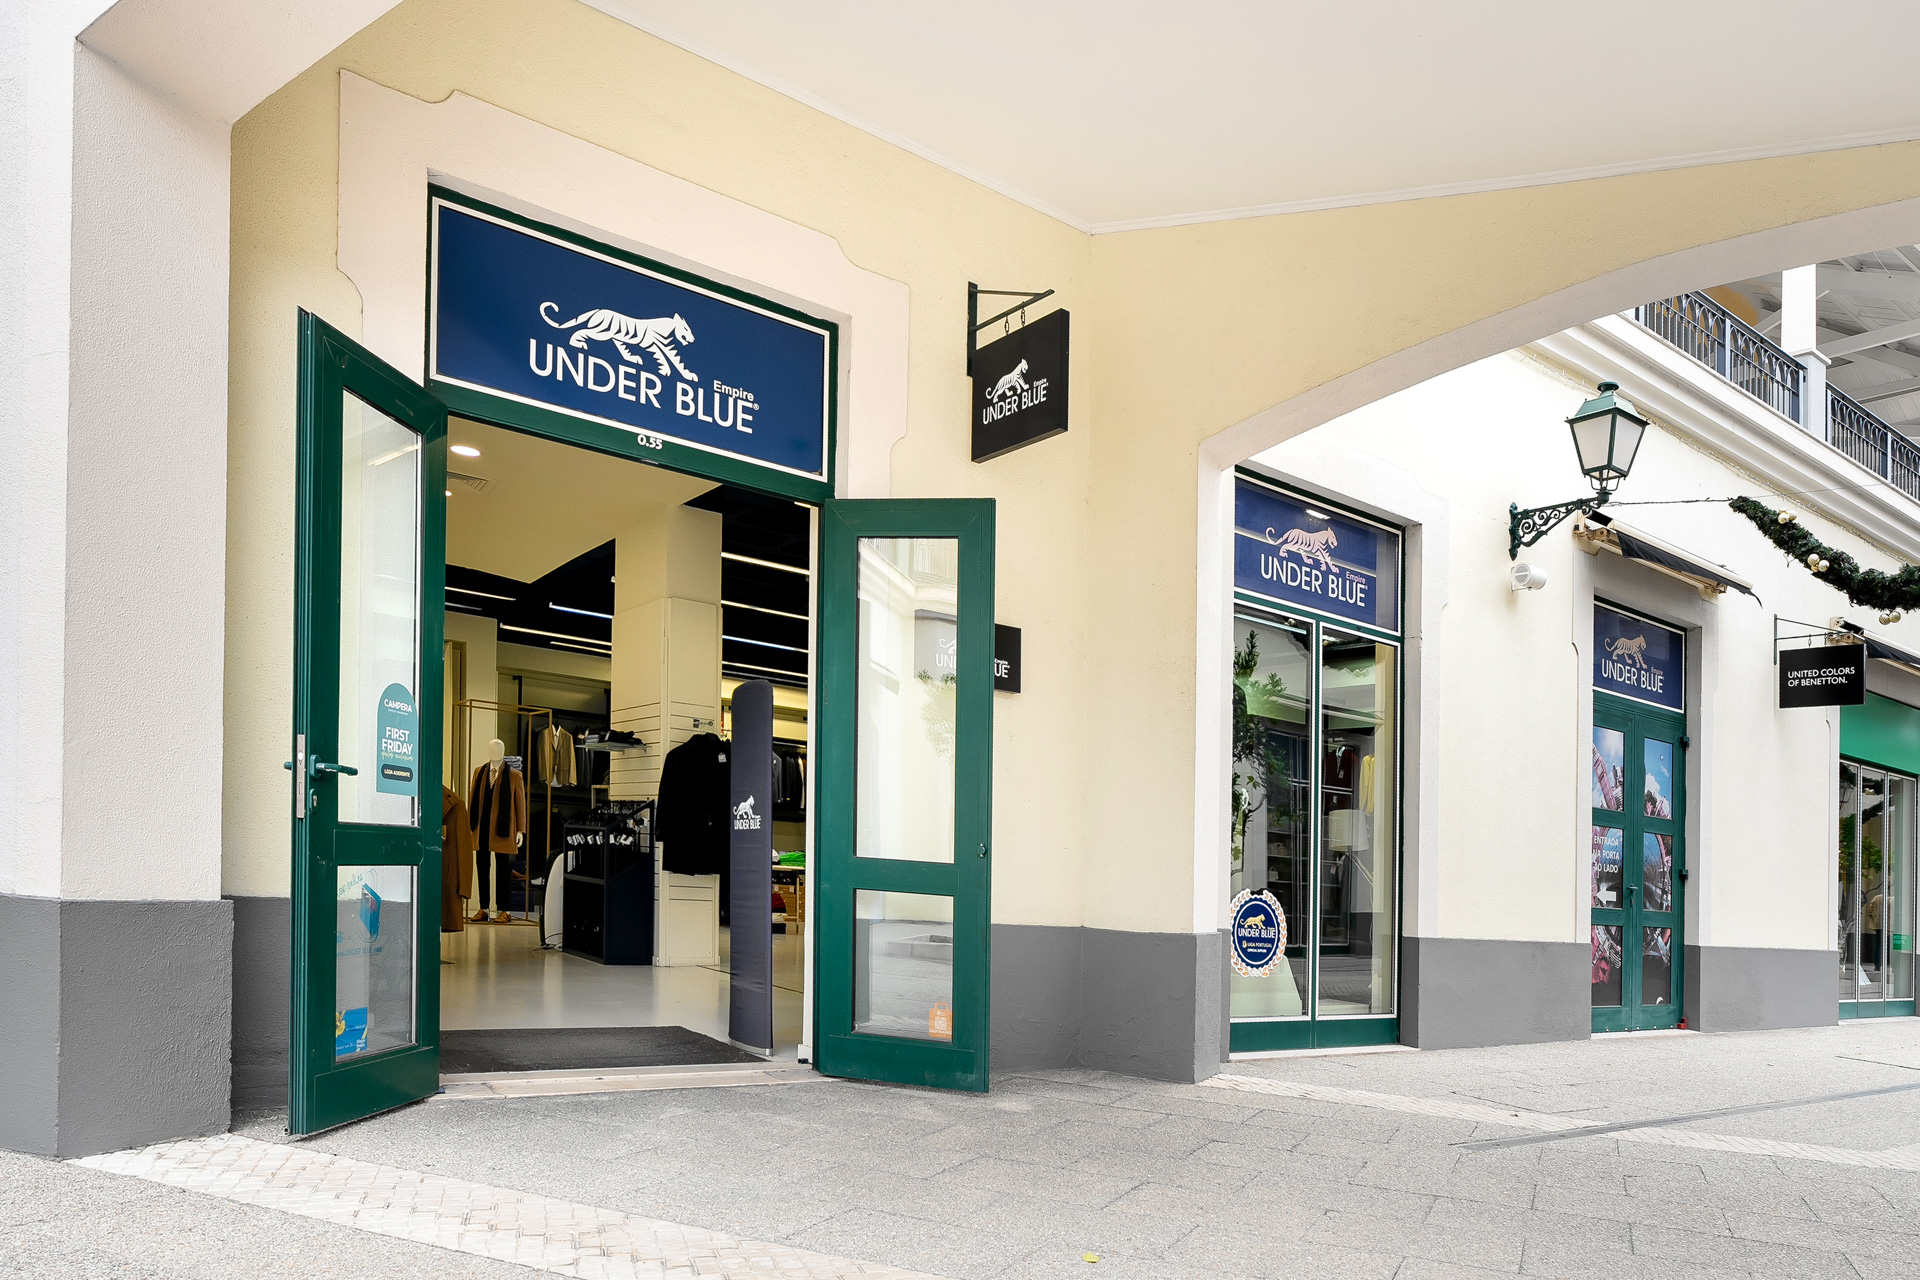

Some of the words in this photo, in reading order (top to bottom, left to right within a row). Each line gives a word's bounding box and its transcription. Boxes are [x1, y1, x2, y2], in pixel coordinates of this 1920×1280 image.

[529, 338, 662, 409] UNDER
[713, 379, 754, 402] Empire
[982, 397, 1018, 425] UNDER
[637, 434, 663, 450] 0.55
[1260, 553, 1323, 595] UNDER
[1345, 571, 1366, 584] Empire
[994, 663, 1008, 678] UE
[1601, 658, 1638, 686] UNDER
[1788, 669, 1819, 679] UNITED
[1820, 667, 1855, 676] COLORS
[1788, 679, 1800, 687] OF
[1801, 676, 1848, 687] BENETTON.
[384, 699, 412, 712] CAMPERA
[386, 727, 409, 741] FIRST
[382, 739, 413, 754] FRIDAY
[733, 819, 750, 830] UNDER
[750, 819, 761, 830] BLUE
[1594, 836, 1618, 845] ENTRADA
[1602, 850, 1620, 860] PORTA
[1603, 864, 1619, 873] LADO
[1238, 927, 1260, 938] UNDER
[1261, 929, 1276, 939] BLUE
